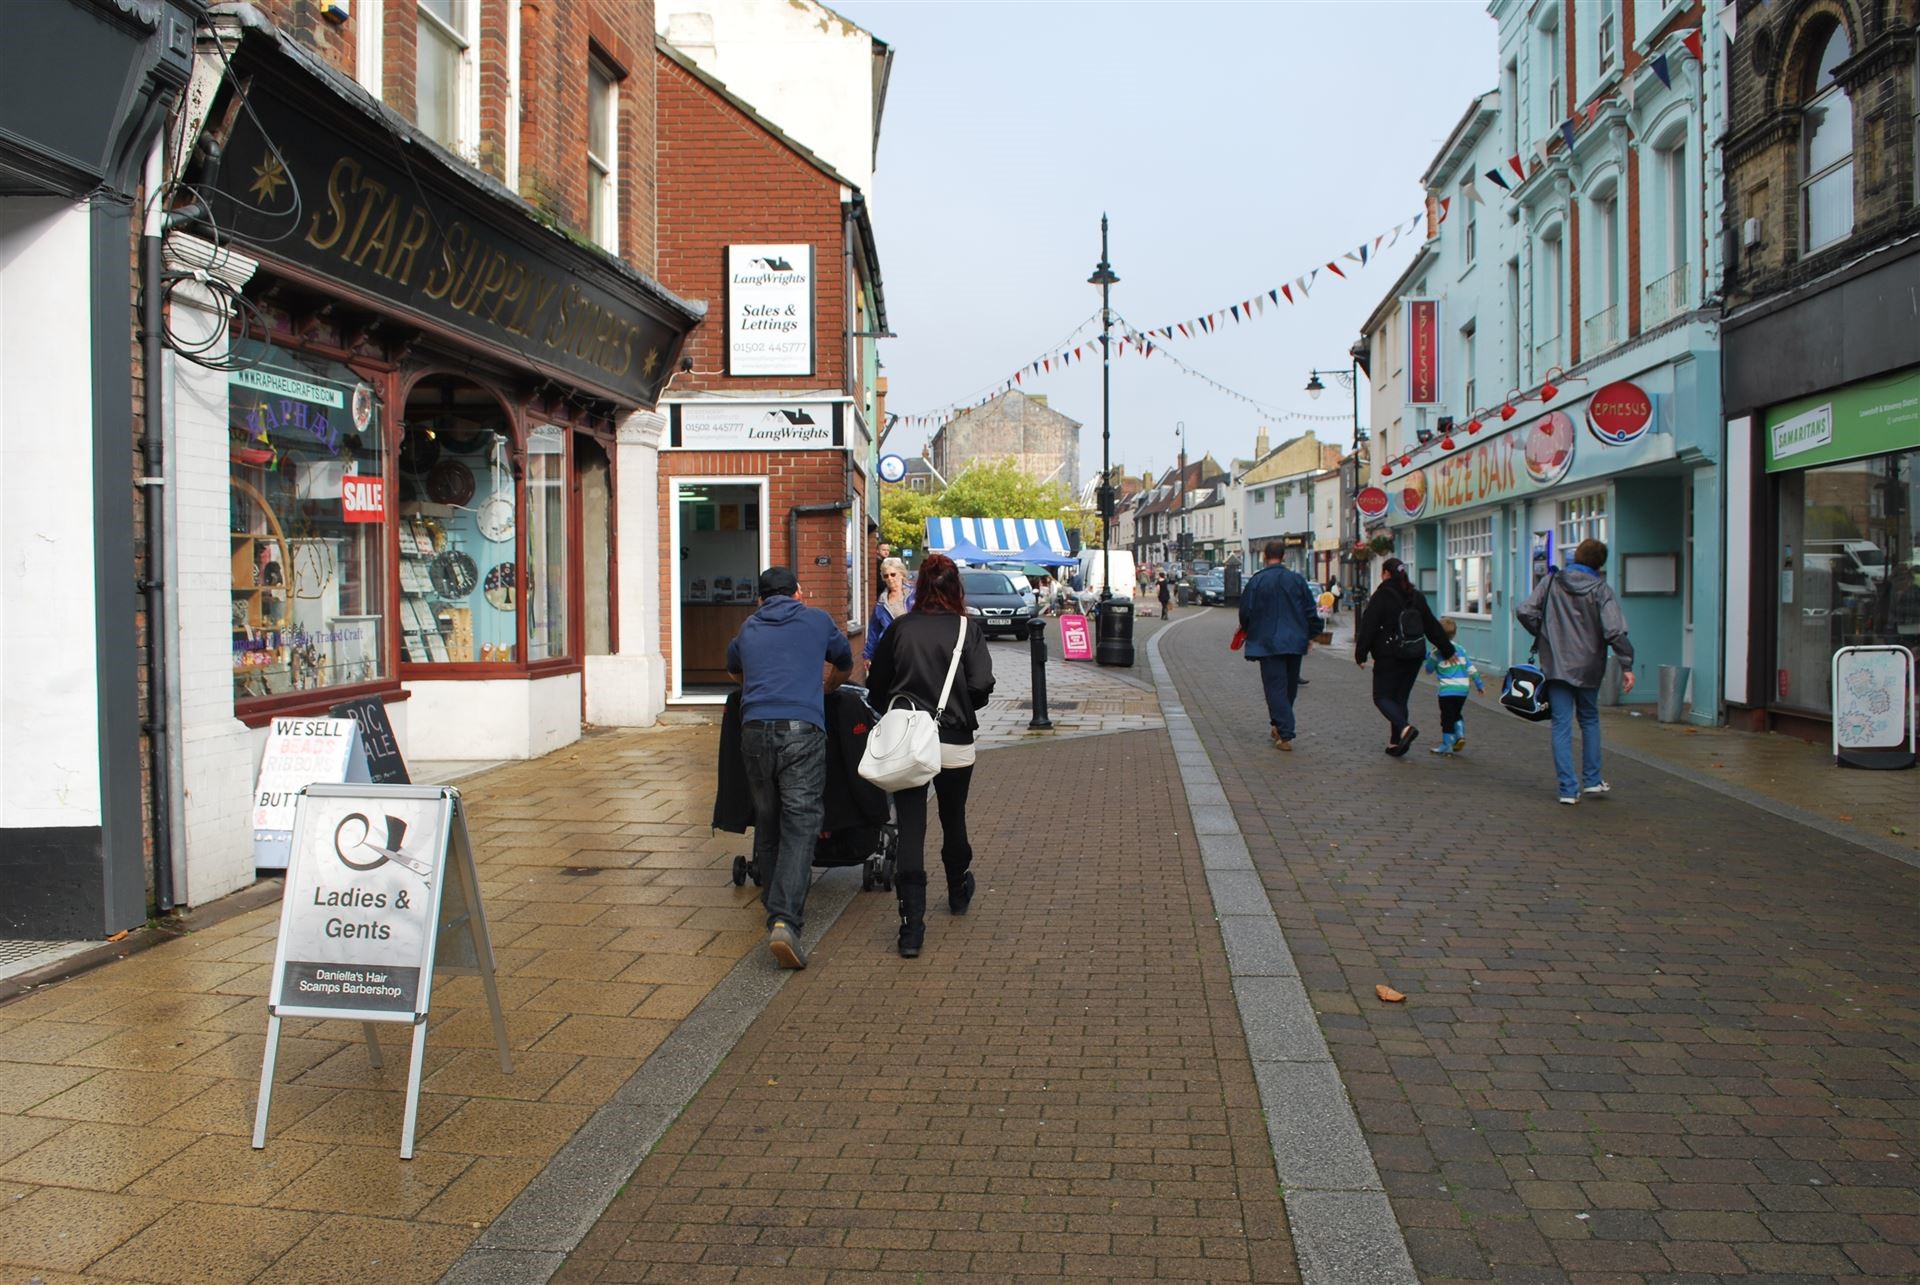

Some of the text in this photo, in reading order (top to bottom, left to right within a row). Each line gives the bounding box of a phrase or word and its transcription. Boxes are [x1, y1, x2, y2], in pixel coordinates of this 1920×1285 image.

[304, 156, 640, 377] STAR SUPPLY STORES
[733, 273, 806, 286] LangWrights
[742, 304, 796, 317] Sales &
[741, 318, 798, 332] Lettings
[733, 342, 807, 353] 01502 445777
[1594, 402, 1647, 416] EPHESUS
[685, 423, 711, 433] 01502
[712, 423, 744, 433] 445777
[748, 426, 829, 441] LangWrights
[1778, 418, 1826, 449] SAMARITANS
[1478, 435, 1516, 499] BAR
[344, 482, 383, 512] SALE
[277, 721, 343, 737] WE SELL
[280, 739, 336, 755] BEADS
[364, 732, 397, 762] ALE
[259, 792, 300, 807] BUTT
[314, 886, 410, 909] Ladies &
[325, 918, 391, 940] Gents
[316, 969, 387, 983] Daniella's Hair
[299, 980, 402, 997] Scamps Barbershop
